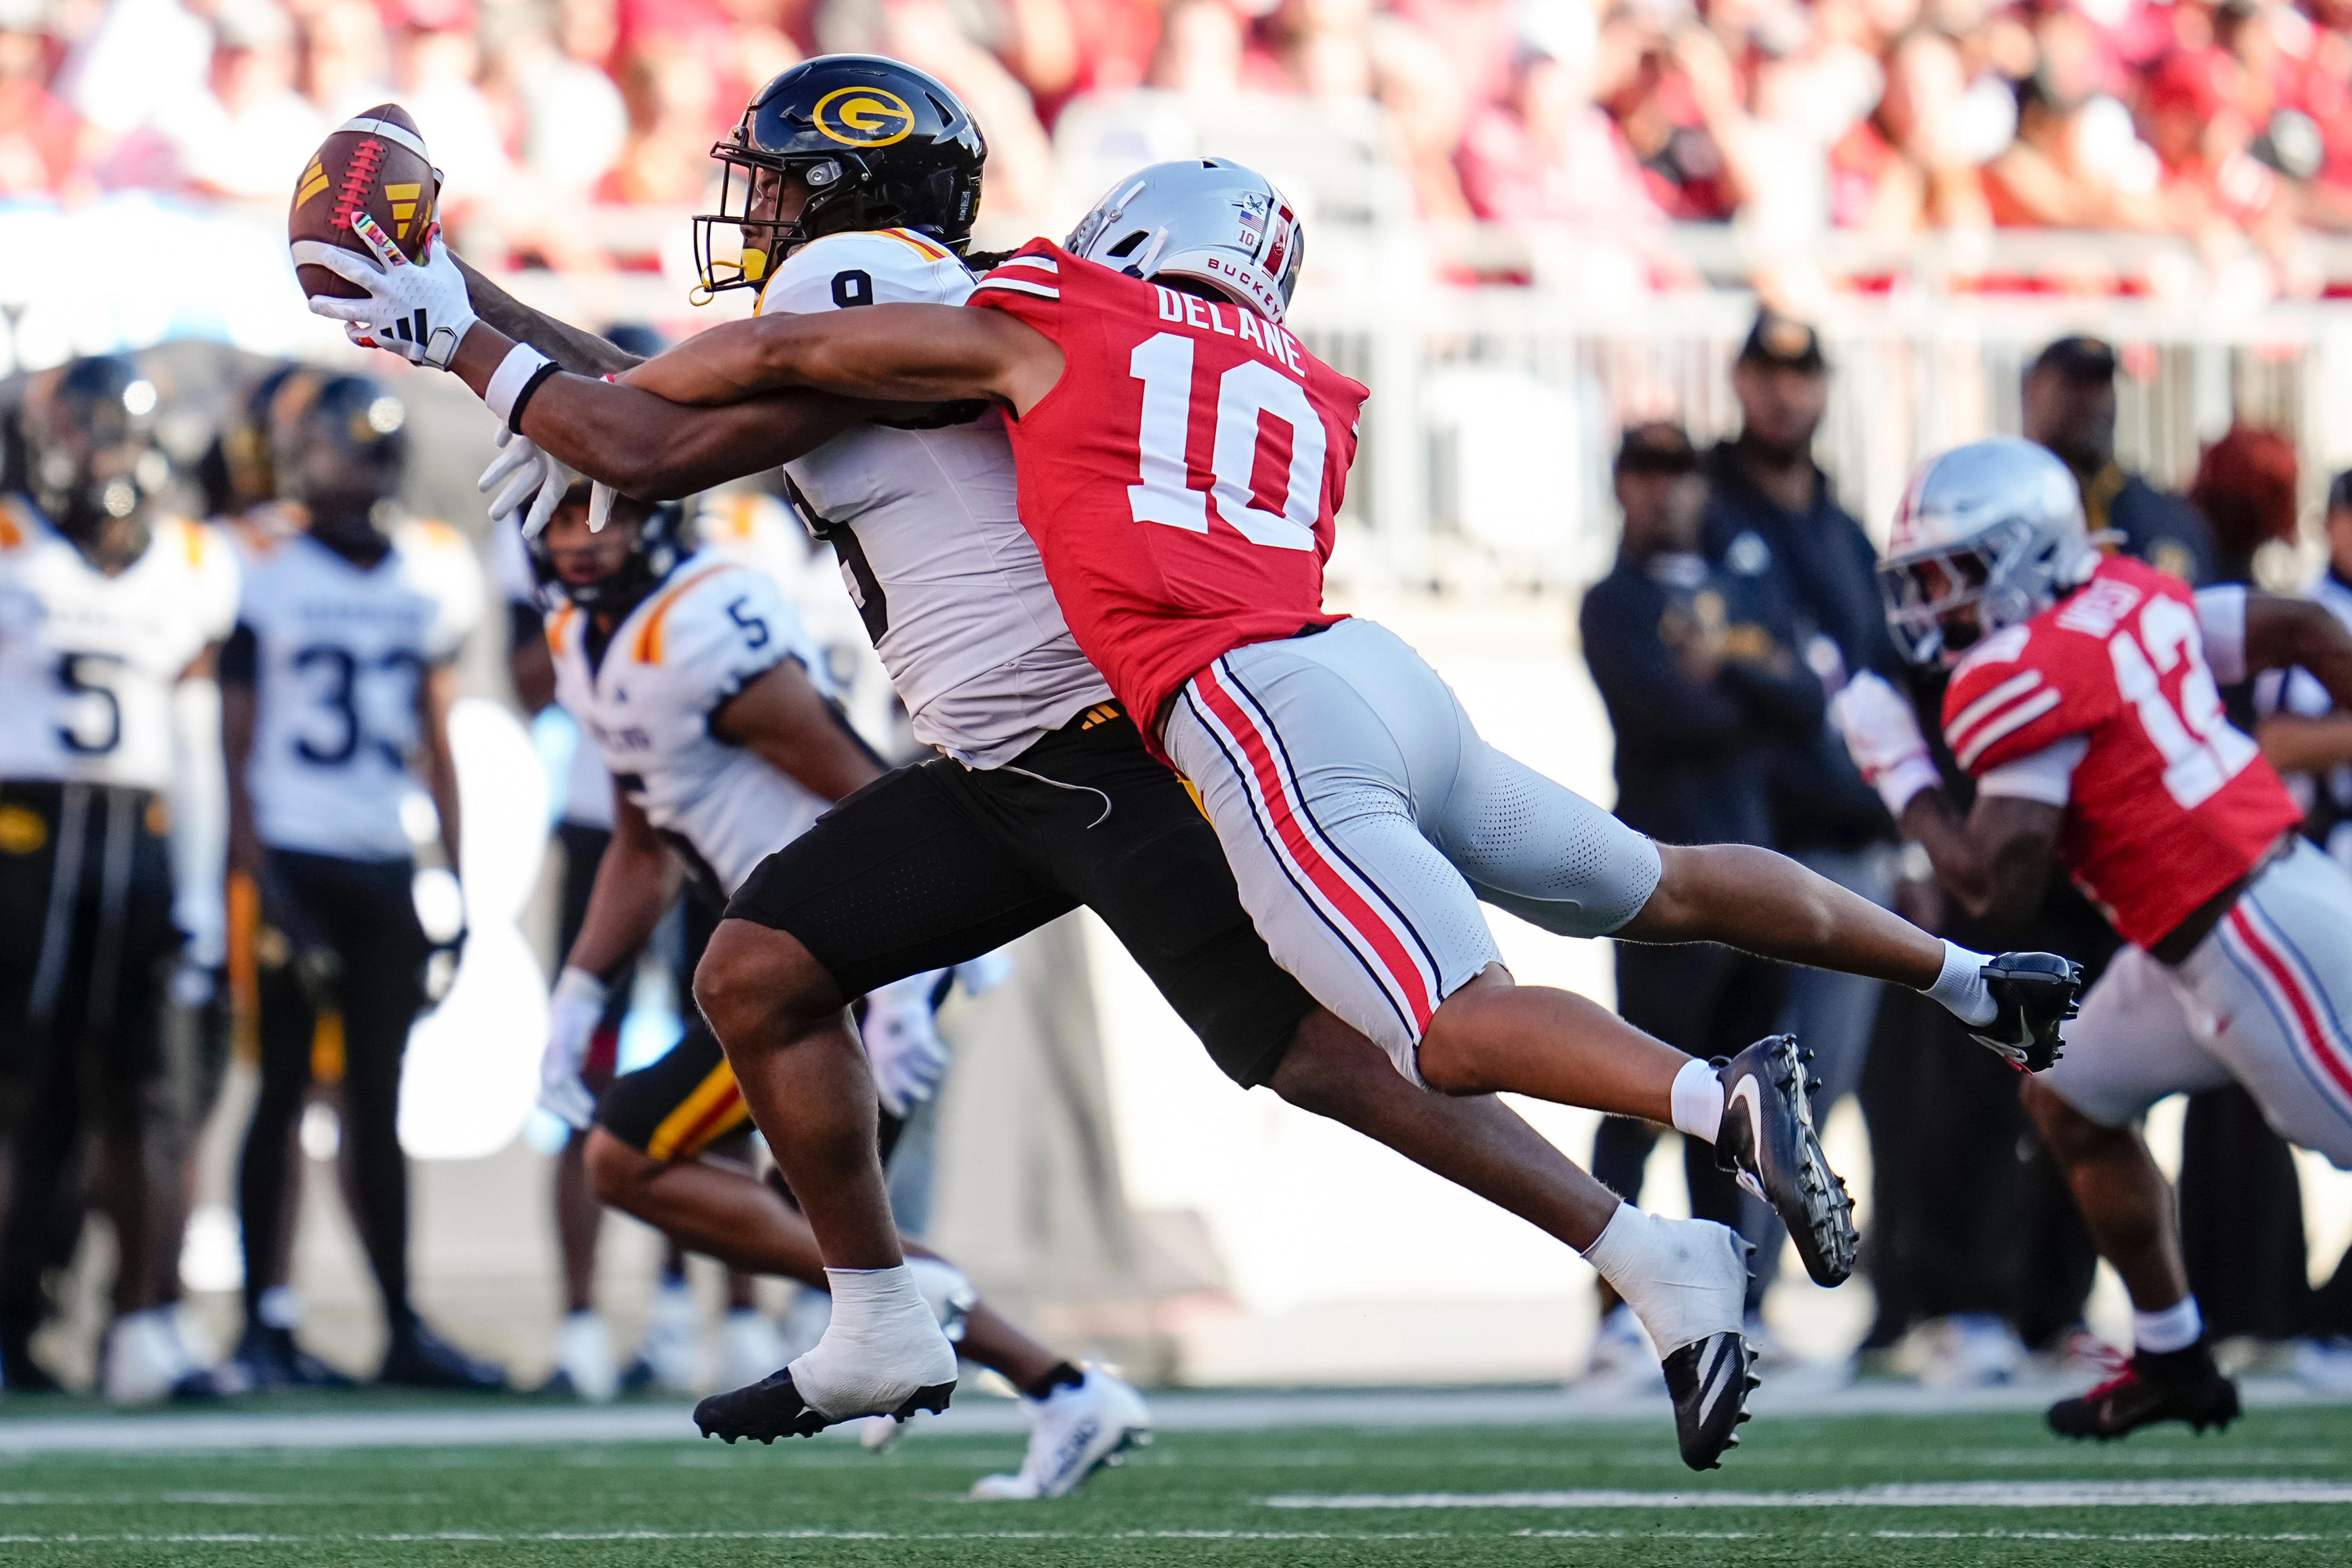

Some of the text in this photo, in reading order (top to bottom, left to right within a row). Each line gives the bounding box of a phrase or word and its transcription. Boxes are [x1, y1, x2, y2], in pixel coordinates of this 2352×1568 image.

[1239, 230, 1254, 247] 10
[1154, 284, 1306, 378] DELANE
[1127, 332, 1326, 552] 10
[726, 596, 768, 649] 5
[56, 650, 124, 757] 5
[2108, 592, 2260, 810] 12
